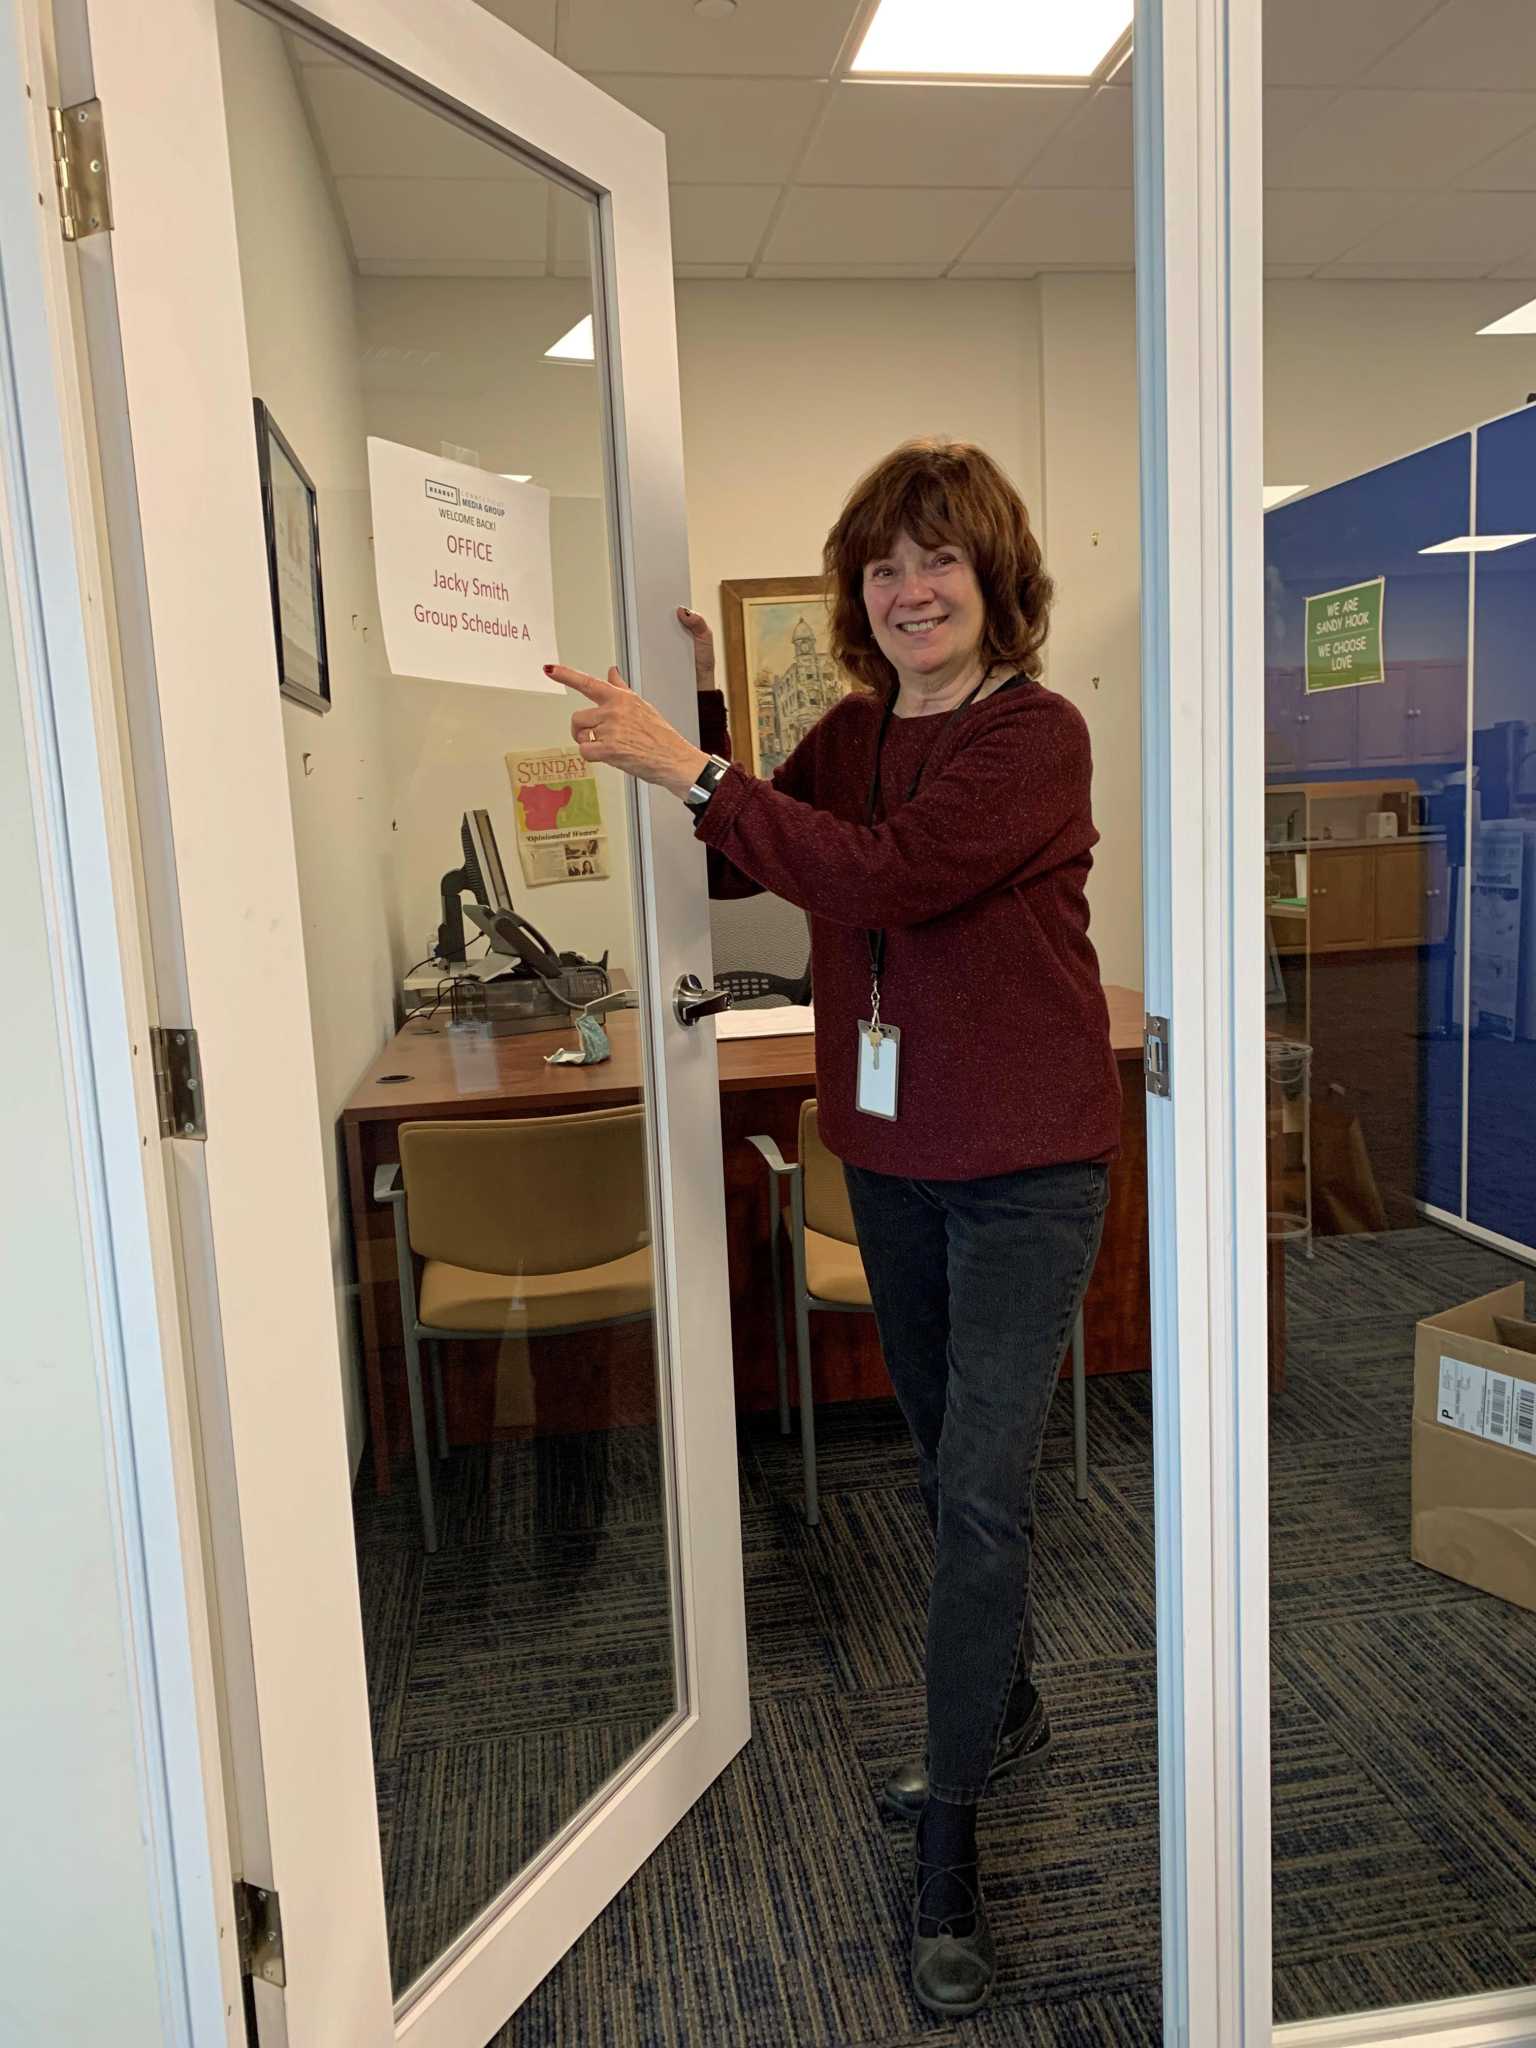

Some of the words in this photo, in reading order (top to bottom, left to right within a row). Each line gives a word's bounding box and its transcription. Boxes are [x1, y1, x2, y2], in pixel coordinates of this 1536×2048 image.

[462, 498, 483, 512] MEDIA
[484, 504, 505, 517] GROUP
[438, 507, 475, 526] WELCOME
[476, 518, 496, 531] BACK!
[446, 534, 493, 562] OFFICE
[433, 569, 469, 597] Jacky
[472, 578, 510, 601] Smith
[1326, 601, 1340, 617] WE
[1342, 597, 1359, 613] ARE
[414, 604, 458, 632] Group
[461, 612, 519, 639] Schedule
[522, 624, 531, 641] A
[1316, 617, 1342, 634] SANDY
[1345, 612, 1369, 628] HOOK
[1317, 643, 1331, 657] WE
[1332, 637, 1366, 655] CHOOSE
[1331, 654, 1353, 671] LOVE
[517, 757, 586, 784] SUNDAY
[1441, 1408, 1454, 1420] P
